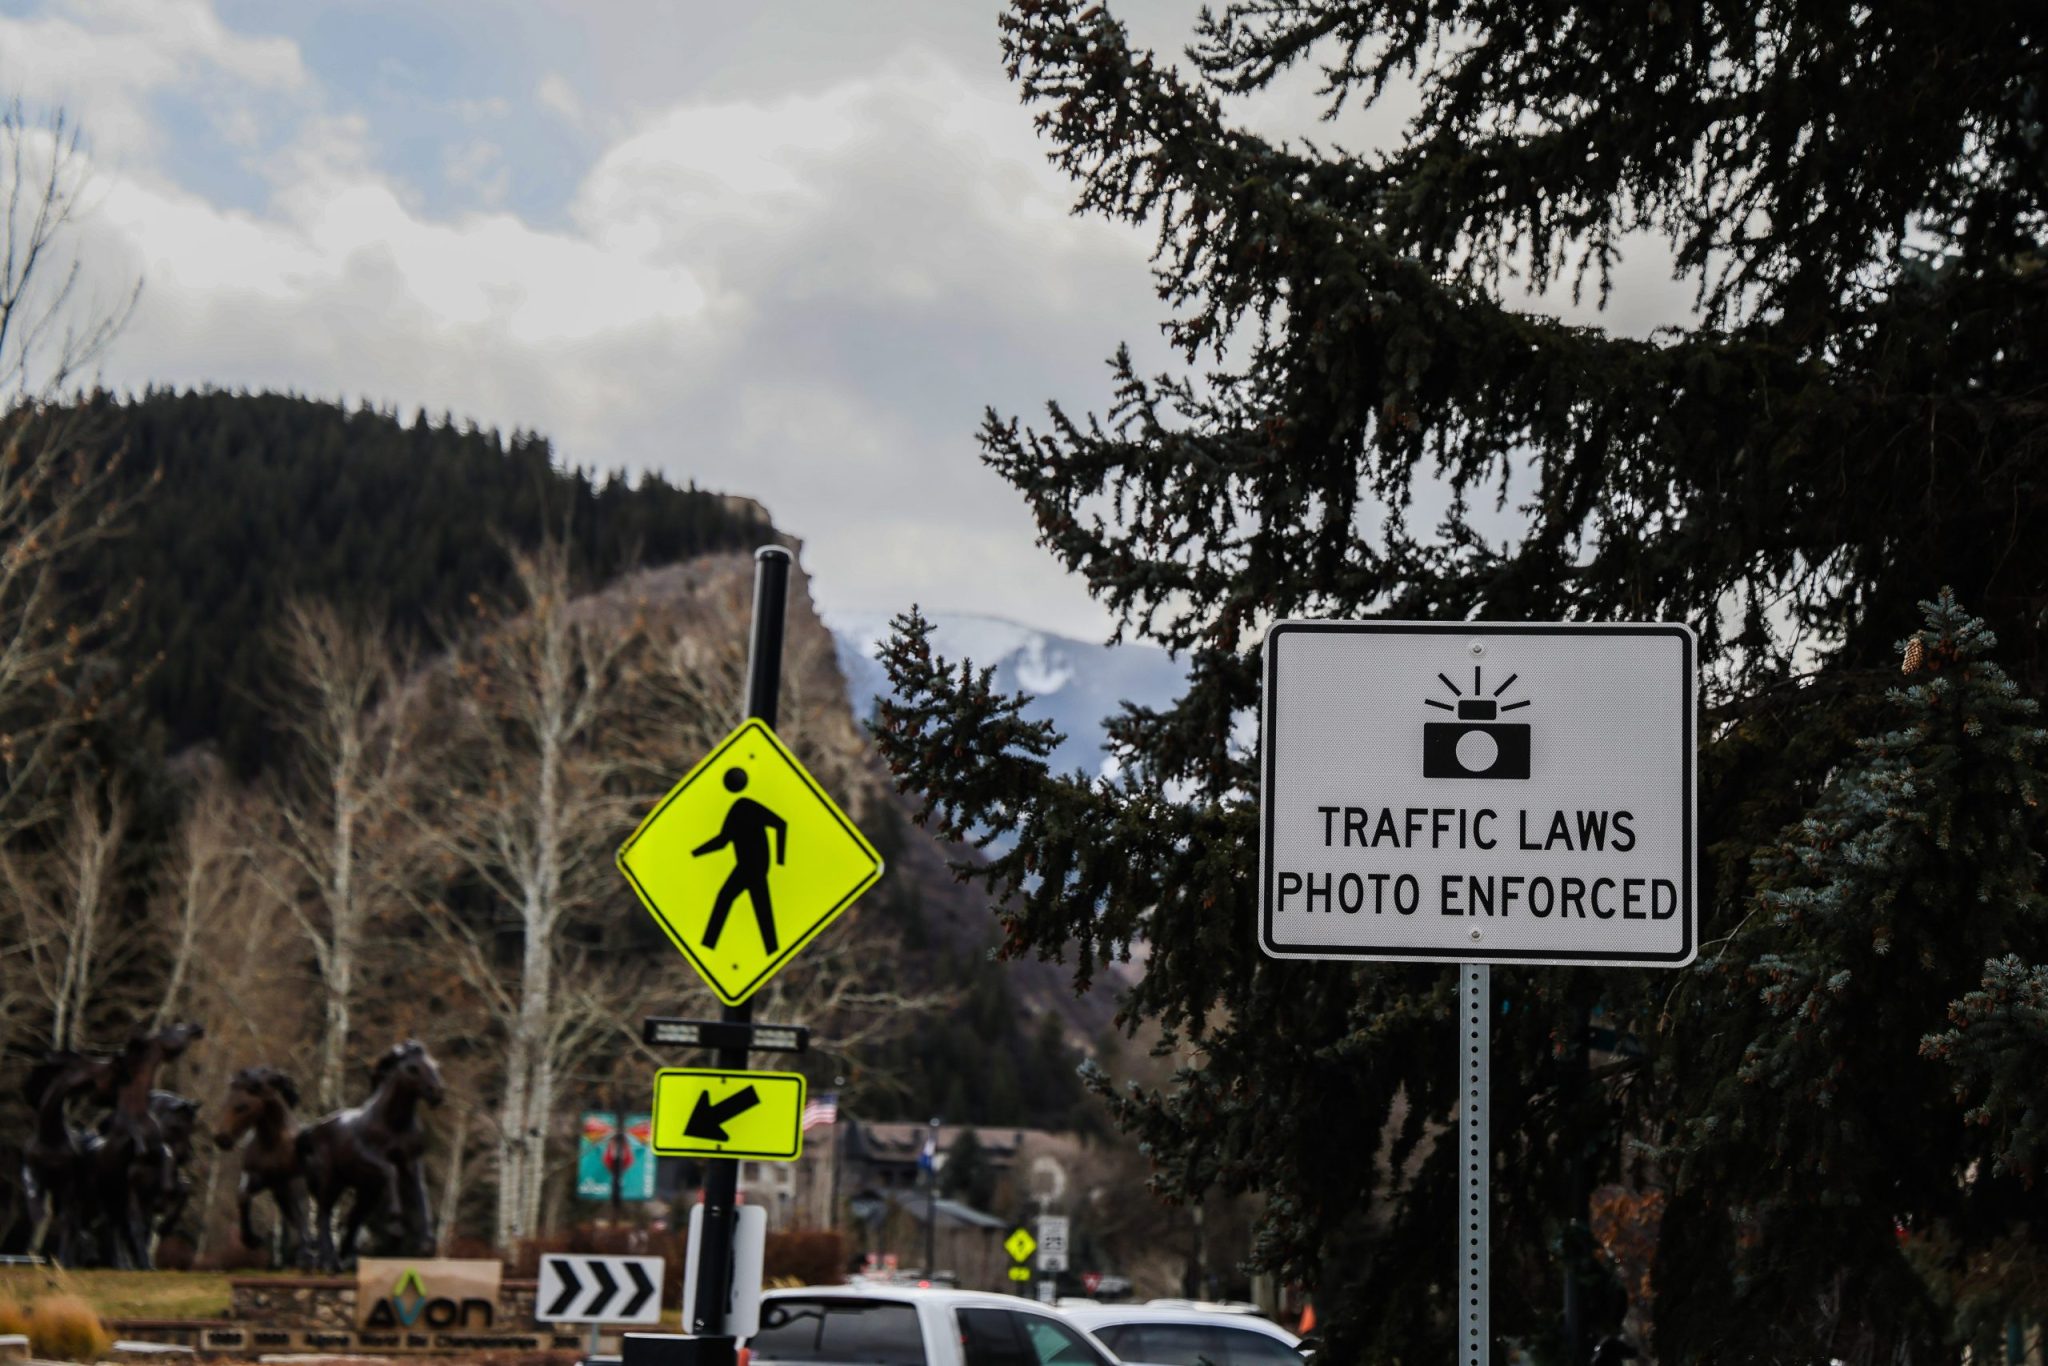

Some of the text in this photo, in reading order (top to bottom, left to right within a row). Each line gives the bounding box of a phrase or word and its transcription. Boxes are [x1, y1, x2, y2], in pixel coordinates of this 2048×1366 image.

[1317, 806, 1636, 853] TRAFFIC LAWS
[1277, 871, 1678, 920] PHOTO ENFORCED
